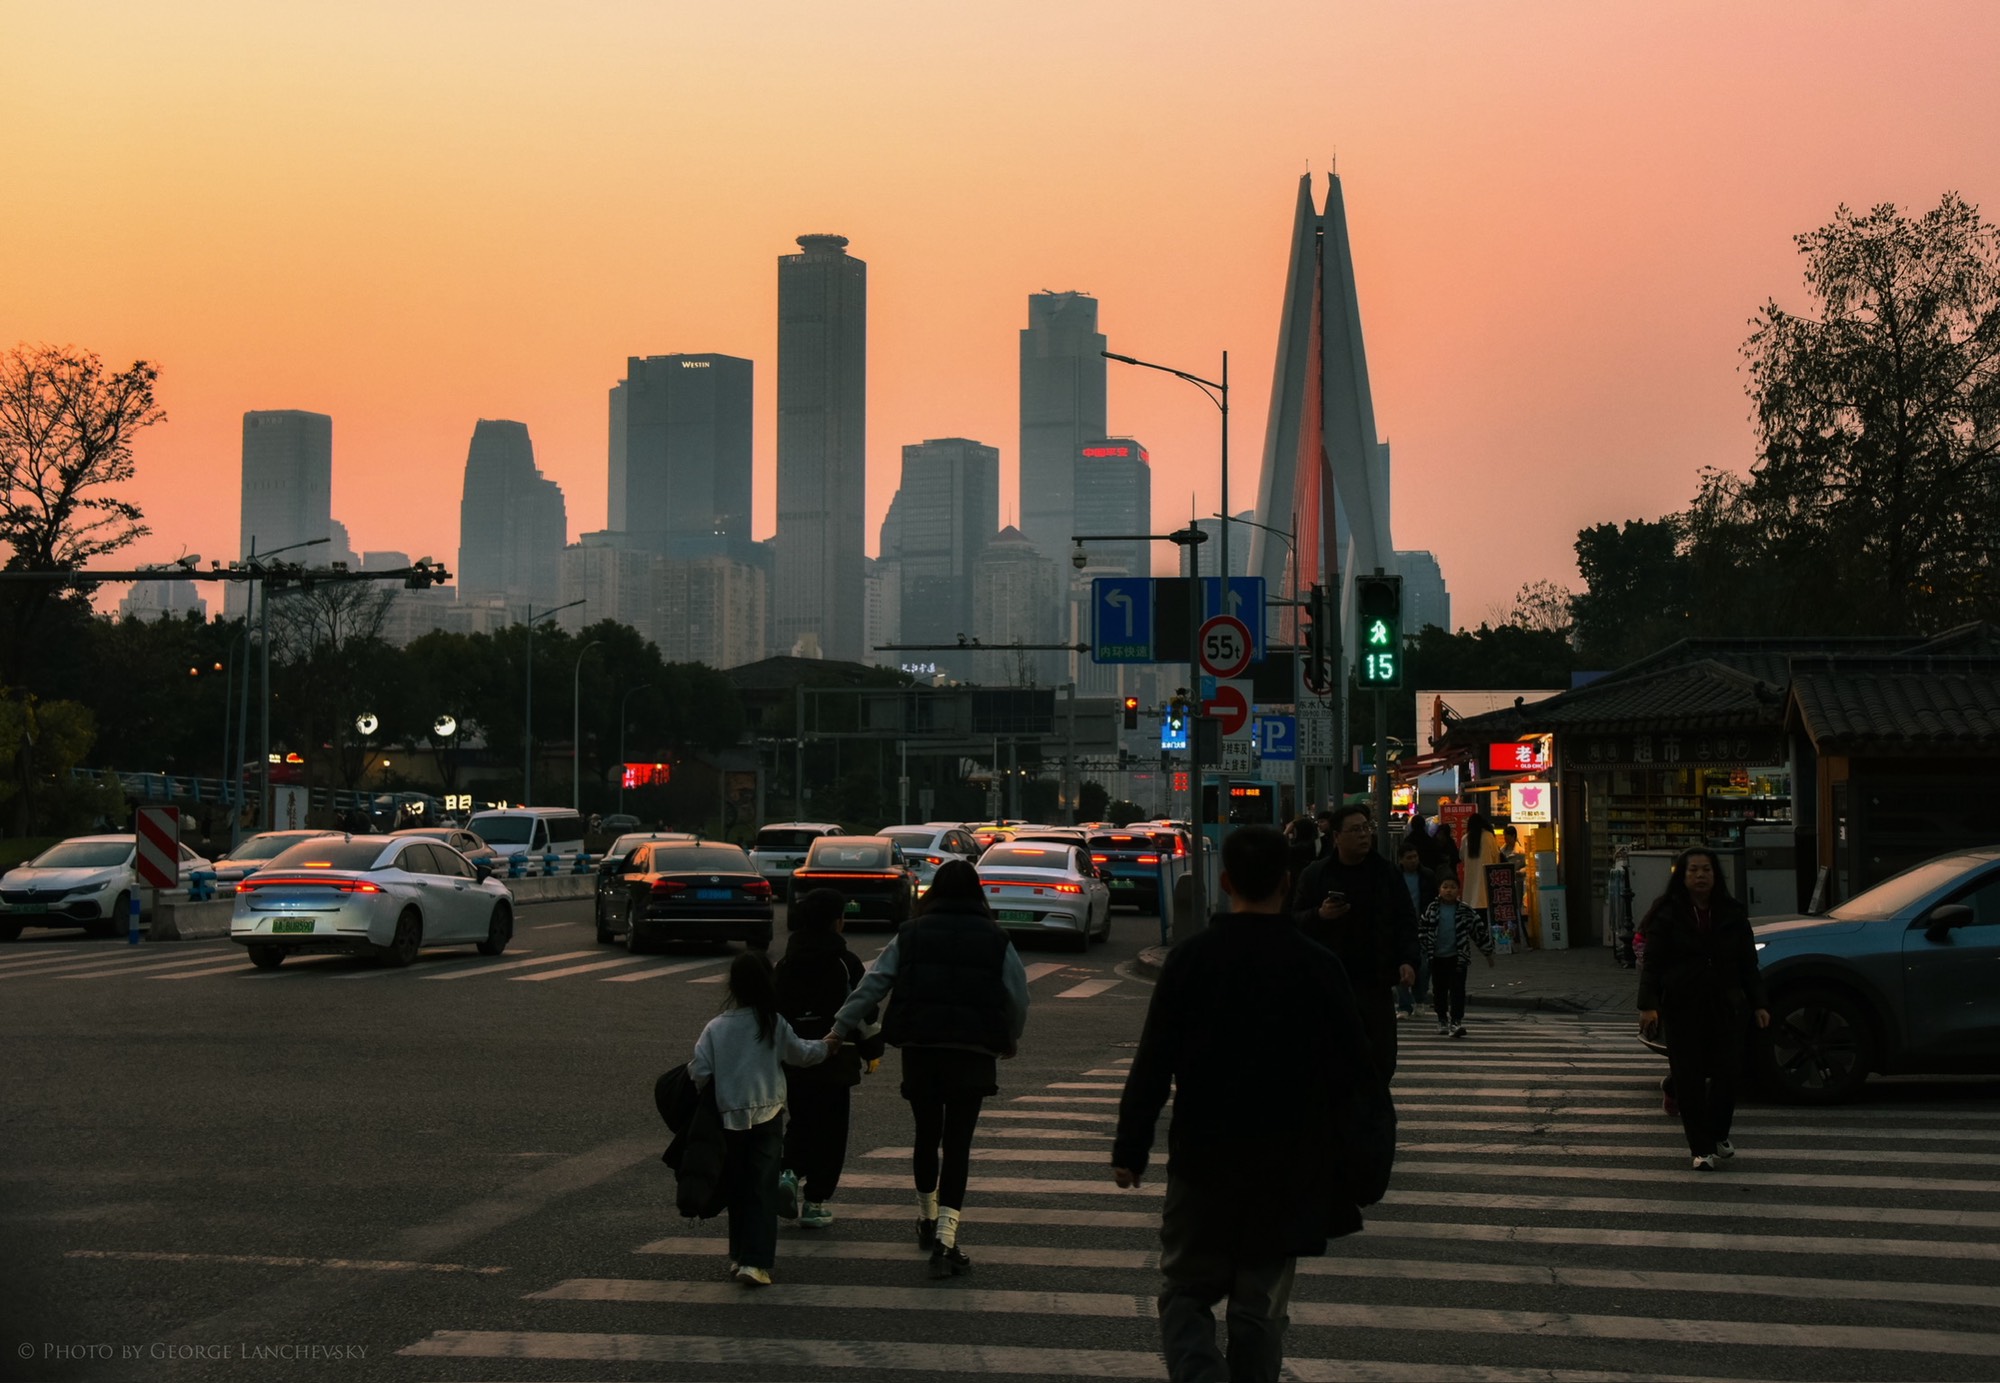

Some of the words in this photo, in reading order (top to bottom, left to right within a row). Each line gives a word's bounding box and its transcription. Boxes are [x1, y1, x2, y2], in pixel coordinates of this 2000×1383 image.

[1100, 645, 1148, 658] 内环快速
[1207, 636, 1240, 659] 55t
[1366, 654, 1393, 679] 15
[1263, 721, 1286, 752] P
[1633, 735, 1681, 763] 超市
[1490, 868, 1516, 923] 烟店超
